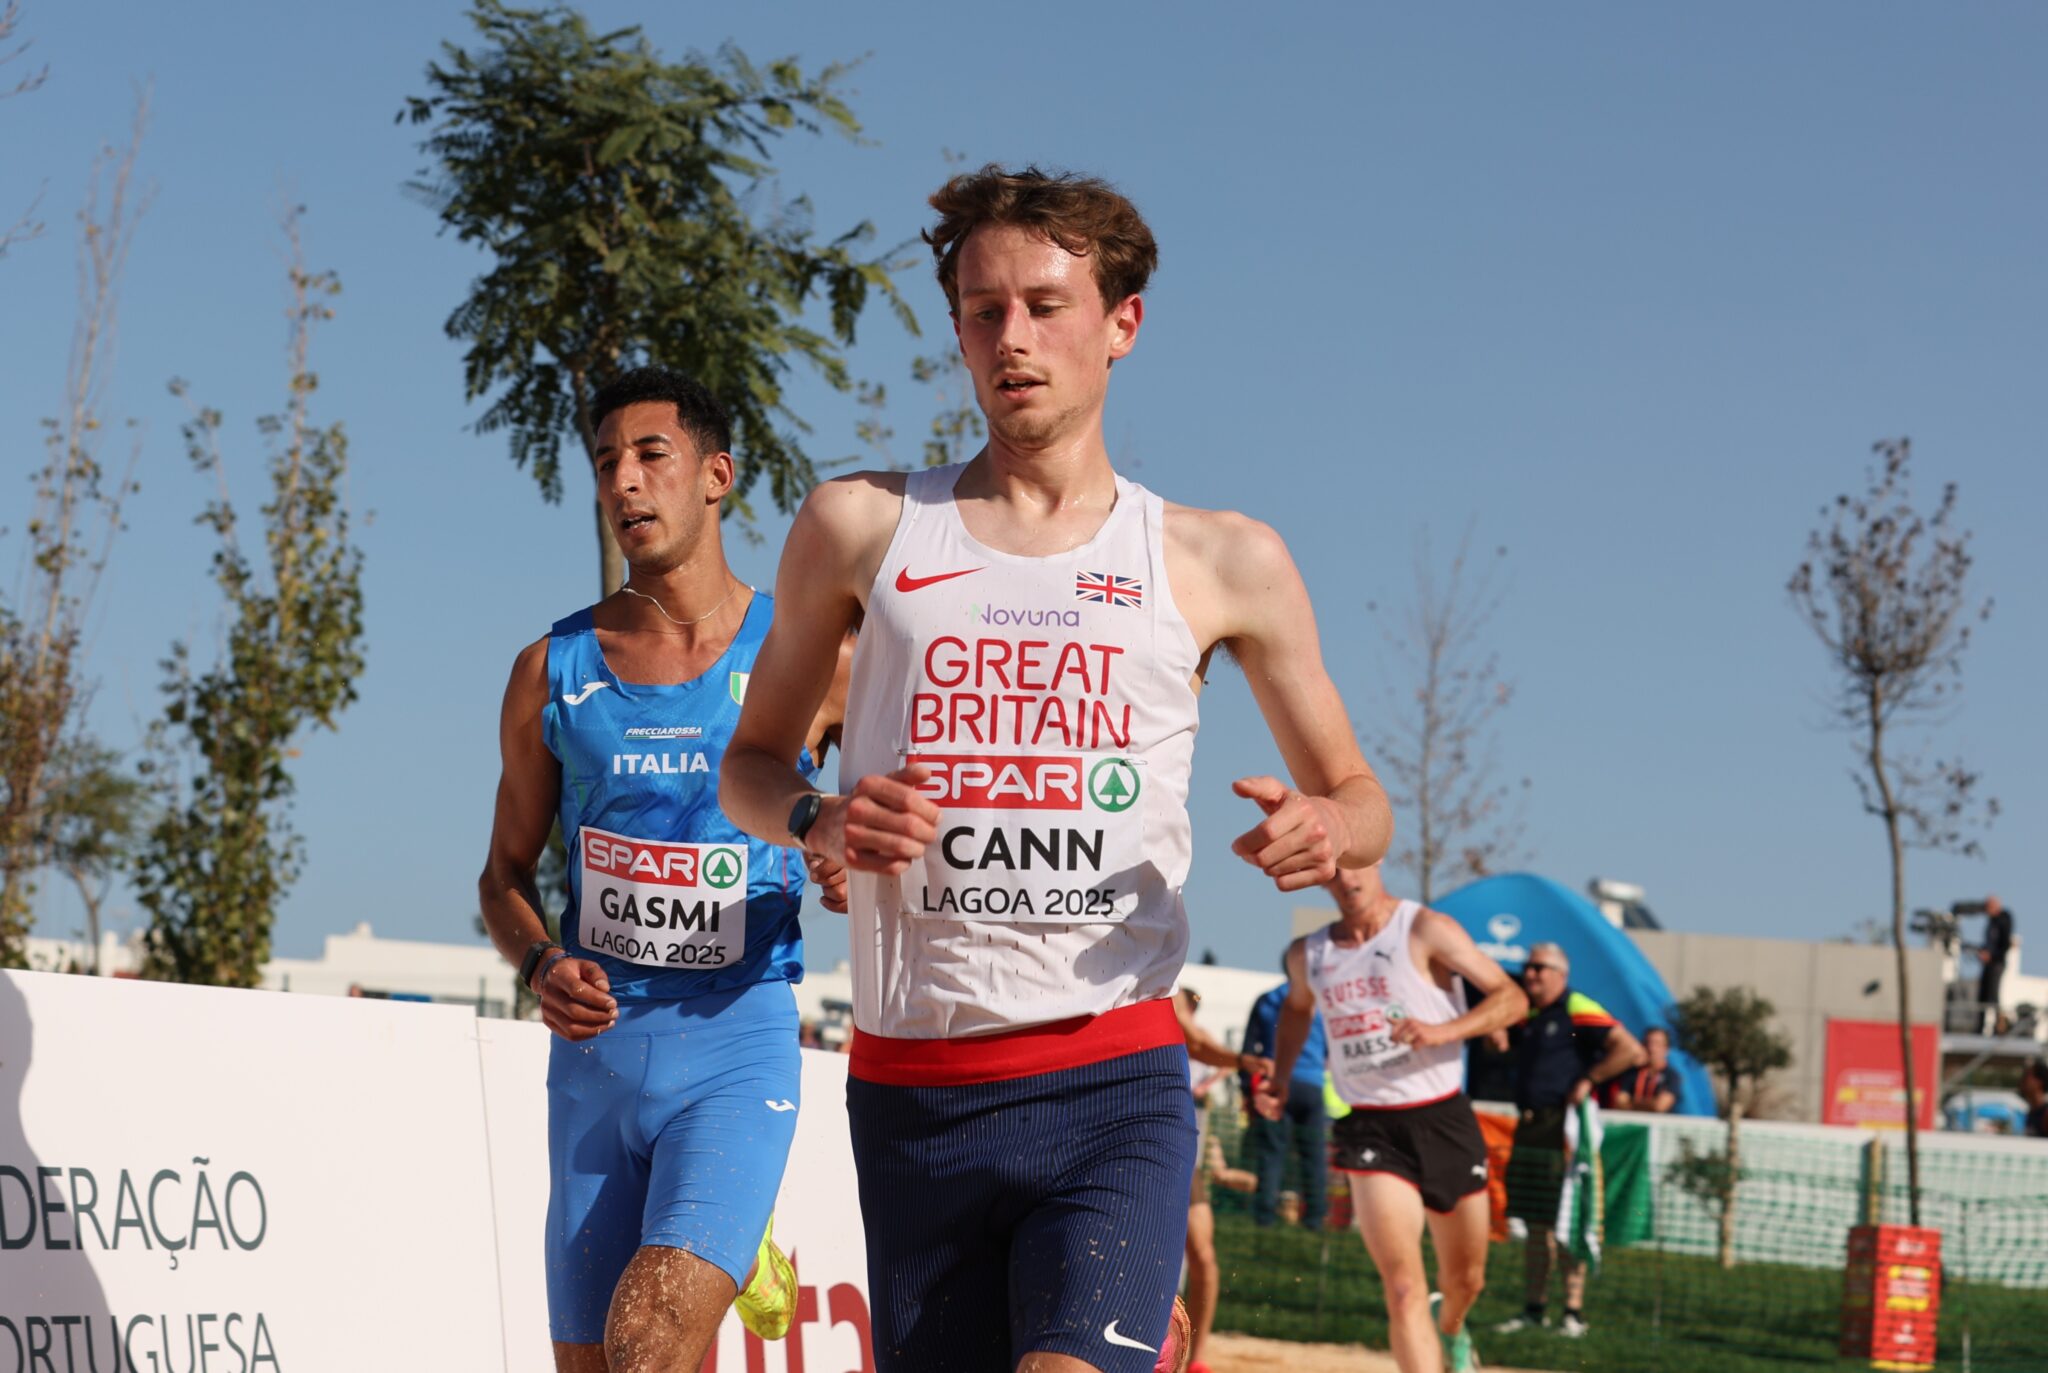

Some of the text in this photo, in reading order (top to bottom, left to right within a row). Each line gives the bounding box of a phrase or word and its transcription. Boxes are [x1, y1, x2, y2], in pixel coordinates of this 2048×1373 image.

[972, 603, 1080, 627] Novuna
[924, 635, 1125, 695] GREAT
[625, 727, 702, 736] FRECCIAROSSA
[911, 693, 1131, 749] BRITAIN
[613, 752, 710, 775] ITALIA
[913, 762, 1077, 802] SPAR
[587, 838, 695, 880] SPAR
[941, 825, 1104, 871] CANN
[600, 887, 720, 932] GASMI
[922, 886, 1115, 915] LAGOA 2025
[591, 927, 726, 965] LAGOA 2025
[0, 1156, 267, 1270] DERAÇÃO
